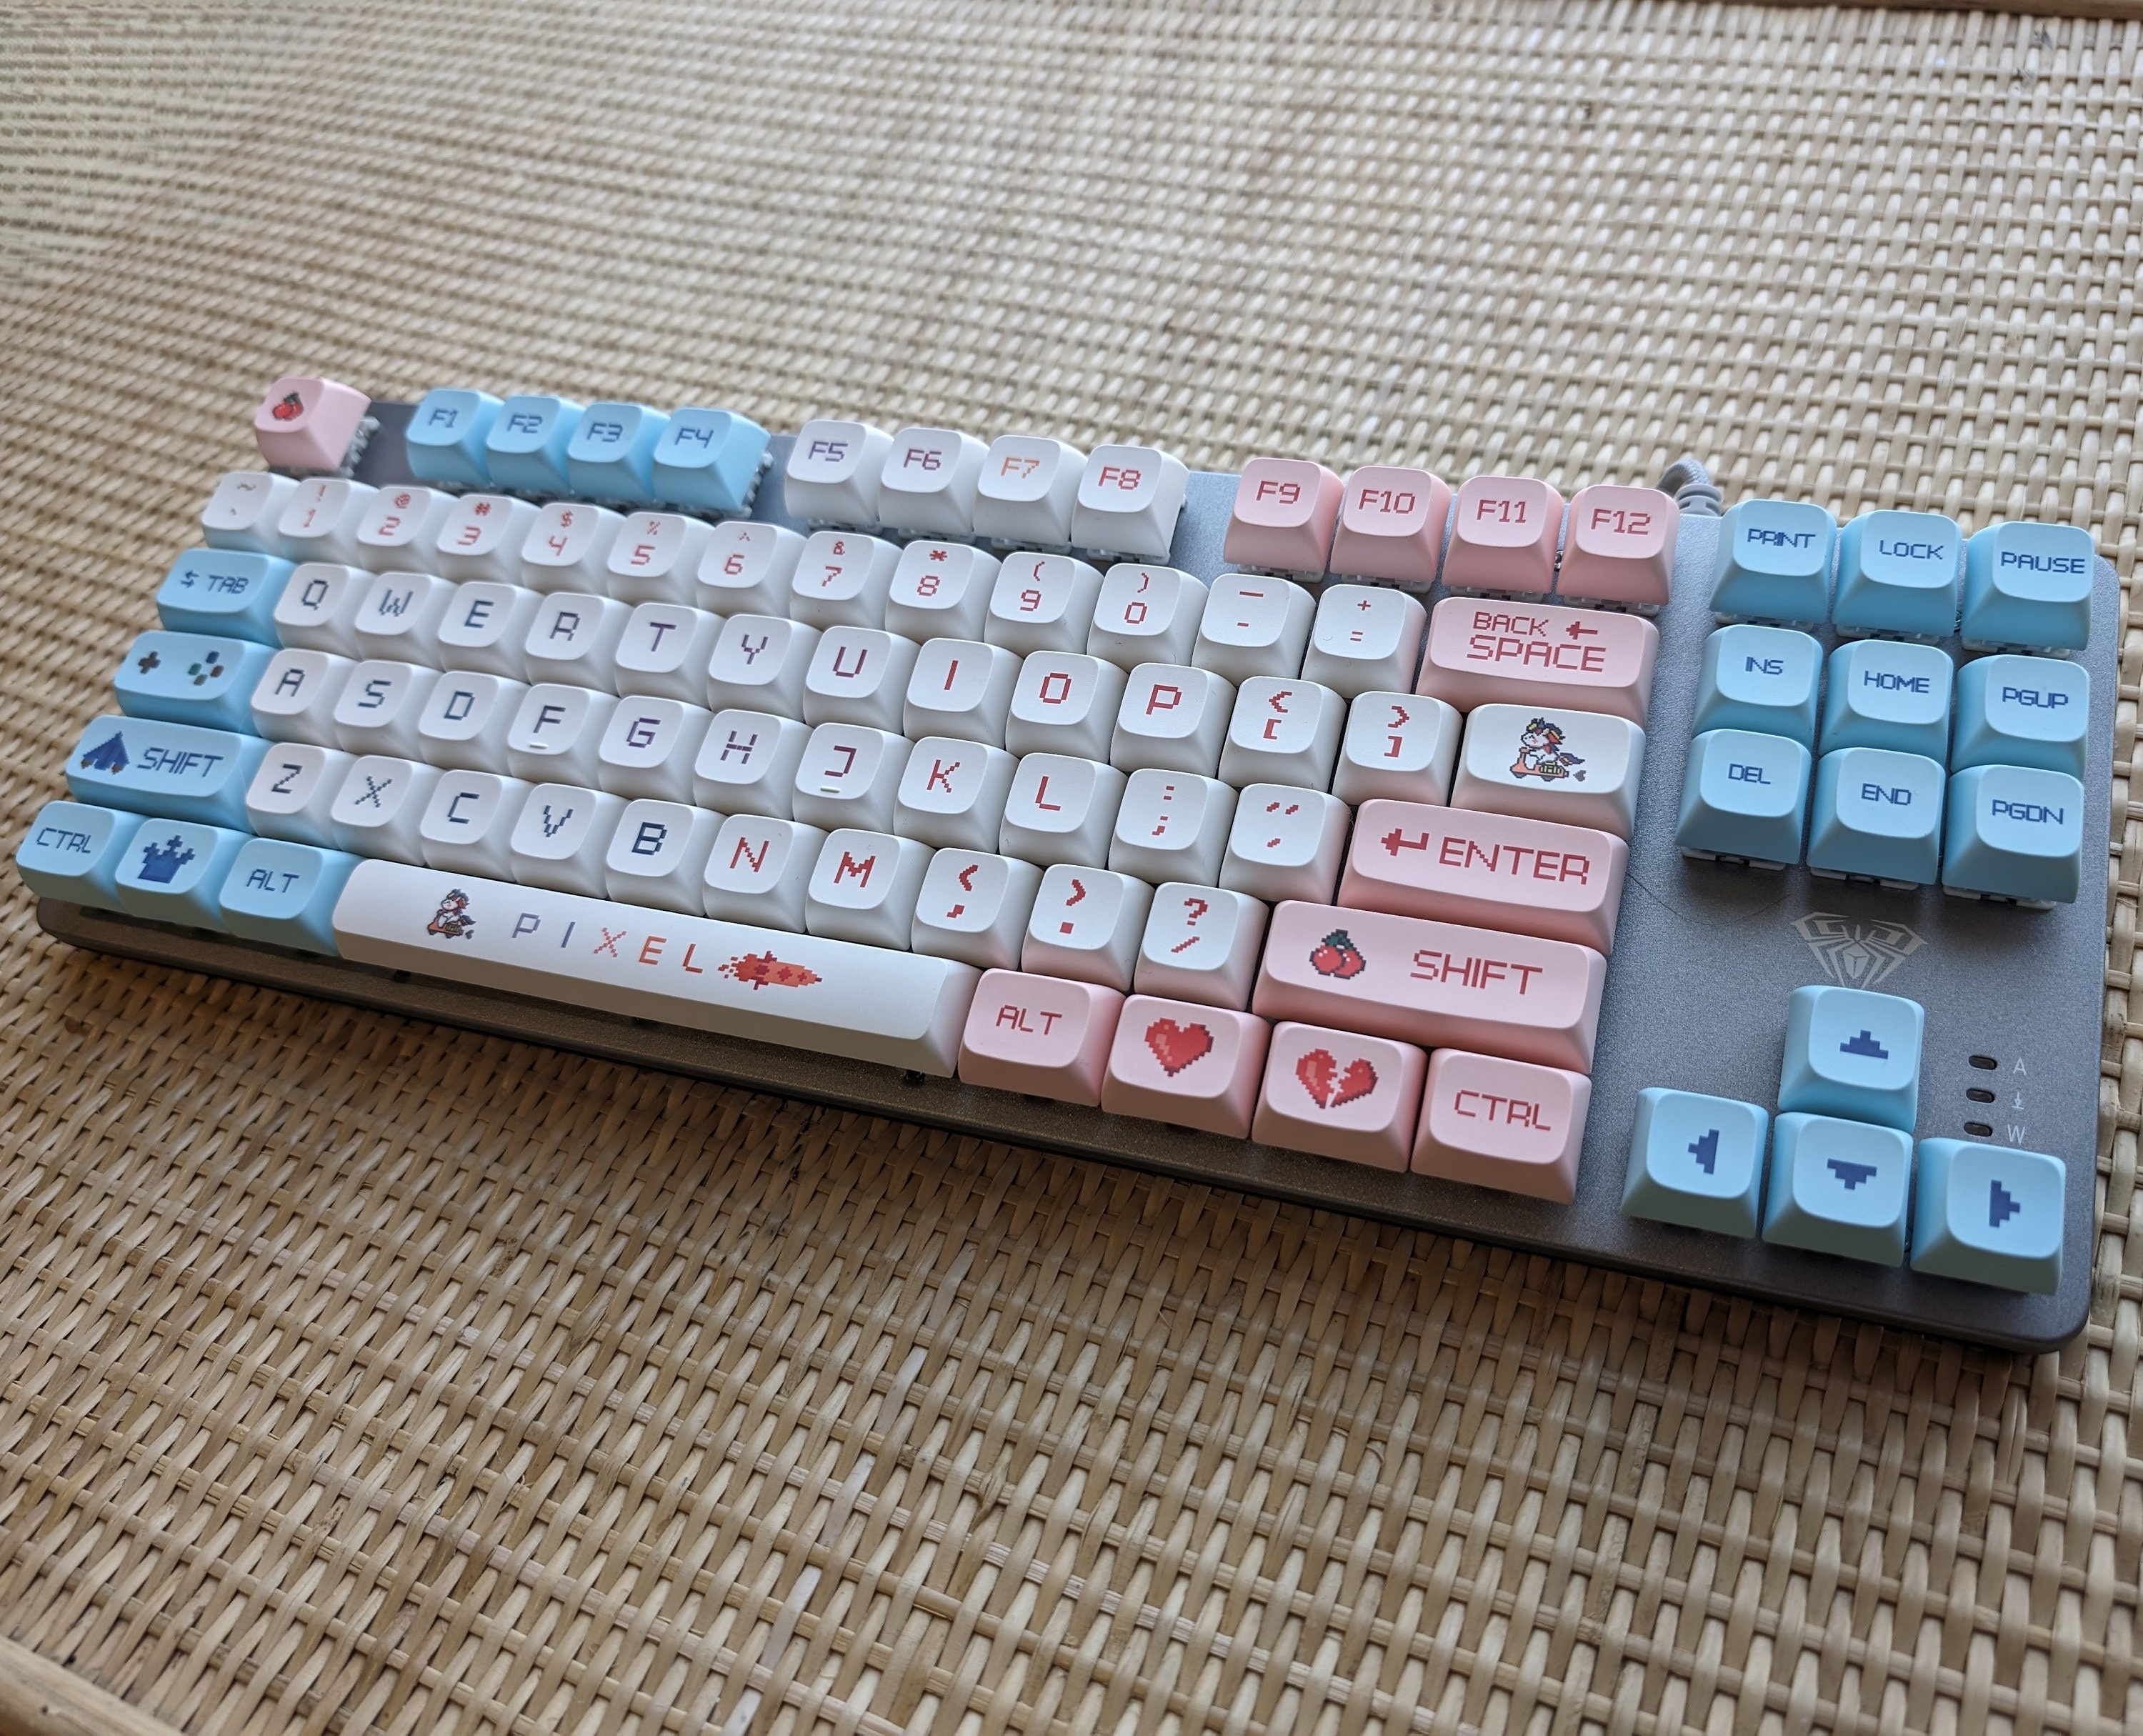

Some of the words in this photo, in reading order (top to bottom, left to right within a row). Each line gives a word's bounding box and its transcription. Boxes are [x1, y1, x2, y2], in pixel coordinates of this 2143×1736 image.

[429, 408, 459, 428] F1
[507, 413, 543, 434] F2
[587, 421, 623, 442] F3
[675, 427, 714, 448] F4
[809, 441, 848, 462] F5
[904, 449, 941, 470] F6
[1001, 457, 1040, 478] F7
[1099, 467, 1141, 490] F8
[1257, 481, 1300, 504] F9
[1359, 489, 1415, 514] F10
[304, 508, 316, 527] 1
[1477, 499, 1526, 523] F11
[1592, 509, 1651, 535] F12
[379, 516, 401, 536] 2
[458, 526, 481, 545] 3
[1747, 529, 1816, 548] PRINT
[549, 536, 568, 556] 4
[631, 544, 655, 565] 5
[1879, 540, 1943, 559] LOCK
[724, 554, 744, 574] 6
[2001, 552, 2084, 574] PAUSE
[209, 574, 249, 594] TAB
[822, 566, 842, 587] 7
[917, 576, 940, 596] 8
[301, 579, 329, 609] Q
[379, 589, 414, 617] W
[1020, 589, 1041, 612] 9
[464, 599, 494, 628] E
[1124, 602, 1147, 624] 0
[1472, 611, 1549, 637] BACK
[550, 612, 580, 641] R
[650, 622, 676, 652] T
[741, 634, 768, 664] Y
[1466, 634, 1607, 673] SPACE
[833, 647, 867, 677] U
[1746, 657, 1783, 674] INS
[275, 669, 305, 697] A
[359, 680, 391, 708] S
[1864, 671, 1929, 693] HOME
[444, 691, 475, 720] D
[1146, 684, 1182, 714] P
[2002, 687, 2069, 709] PGUP
[534, 705, 566, 733] F
[626, 718, 660, 748] G
[721, 731, 757, 764] H
[137, 747, 224, 777] SHIFT
[1729, 764, 1771, 784] DEL
[271, 764, 302, 794] Z
[927, 759, 960, 792] K
[355, 776, 392, 807] X
[1035, 776, 1061, 811] L
[1862, 783, 1912, 805] END
[447, 792, 479, 824] C
[1992, 799, 2064, 824] PGDN
[543, 805, 573, 837] V
[36, 827, 91, 853] CTRL
[631, 822, 667, 855] B
[730, 837, 769, 872] N
[1439, 837, 1589, 884] ENTER
[246, 869, 299, 892] ALT
[834, 852, 876, 887] M
[1411, 949, 1542, 994] SHIFT
[996, 1005, 1062, 1034] ALT
[2012, 1057, 2027, 1075] A
[1454, 1090, 1550, 1131] CTRL
[2007, 1124, 2026, 1145] W
